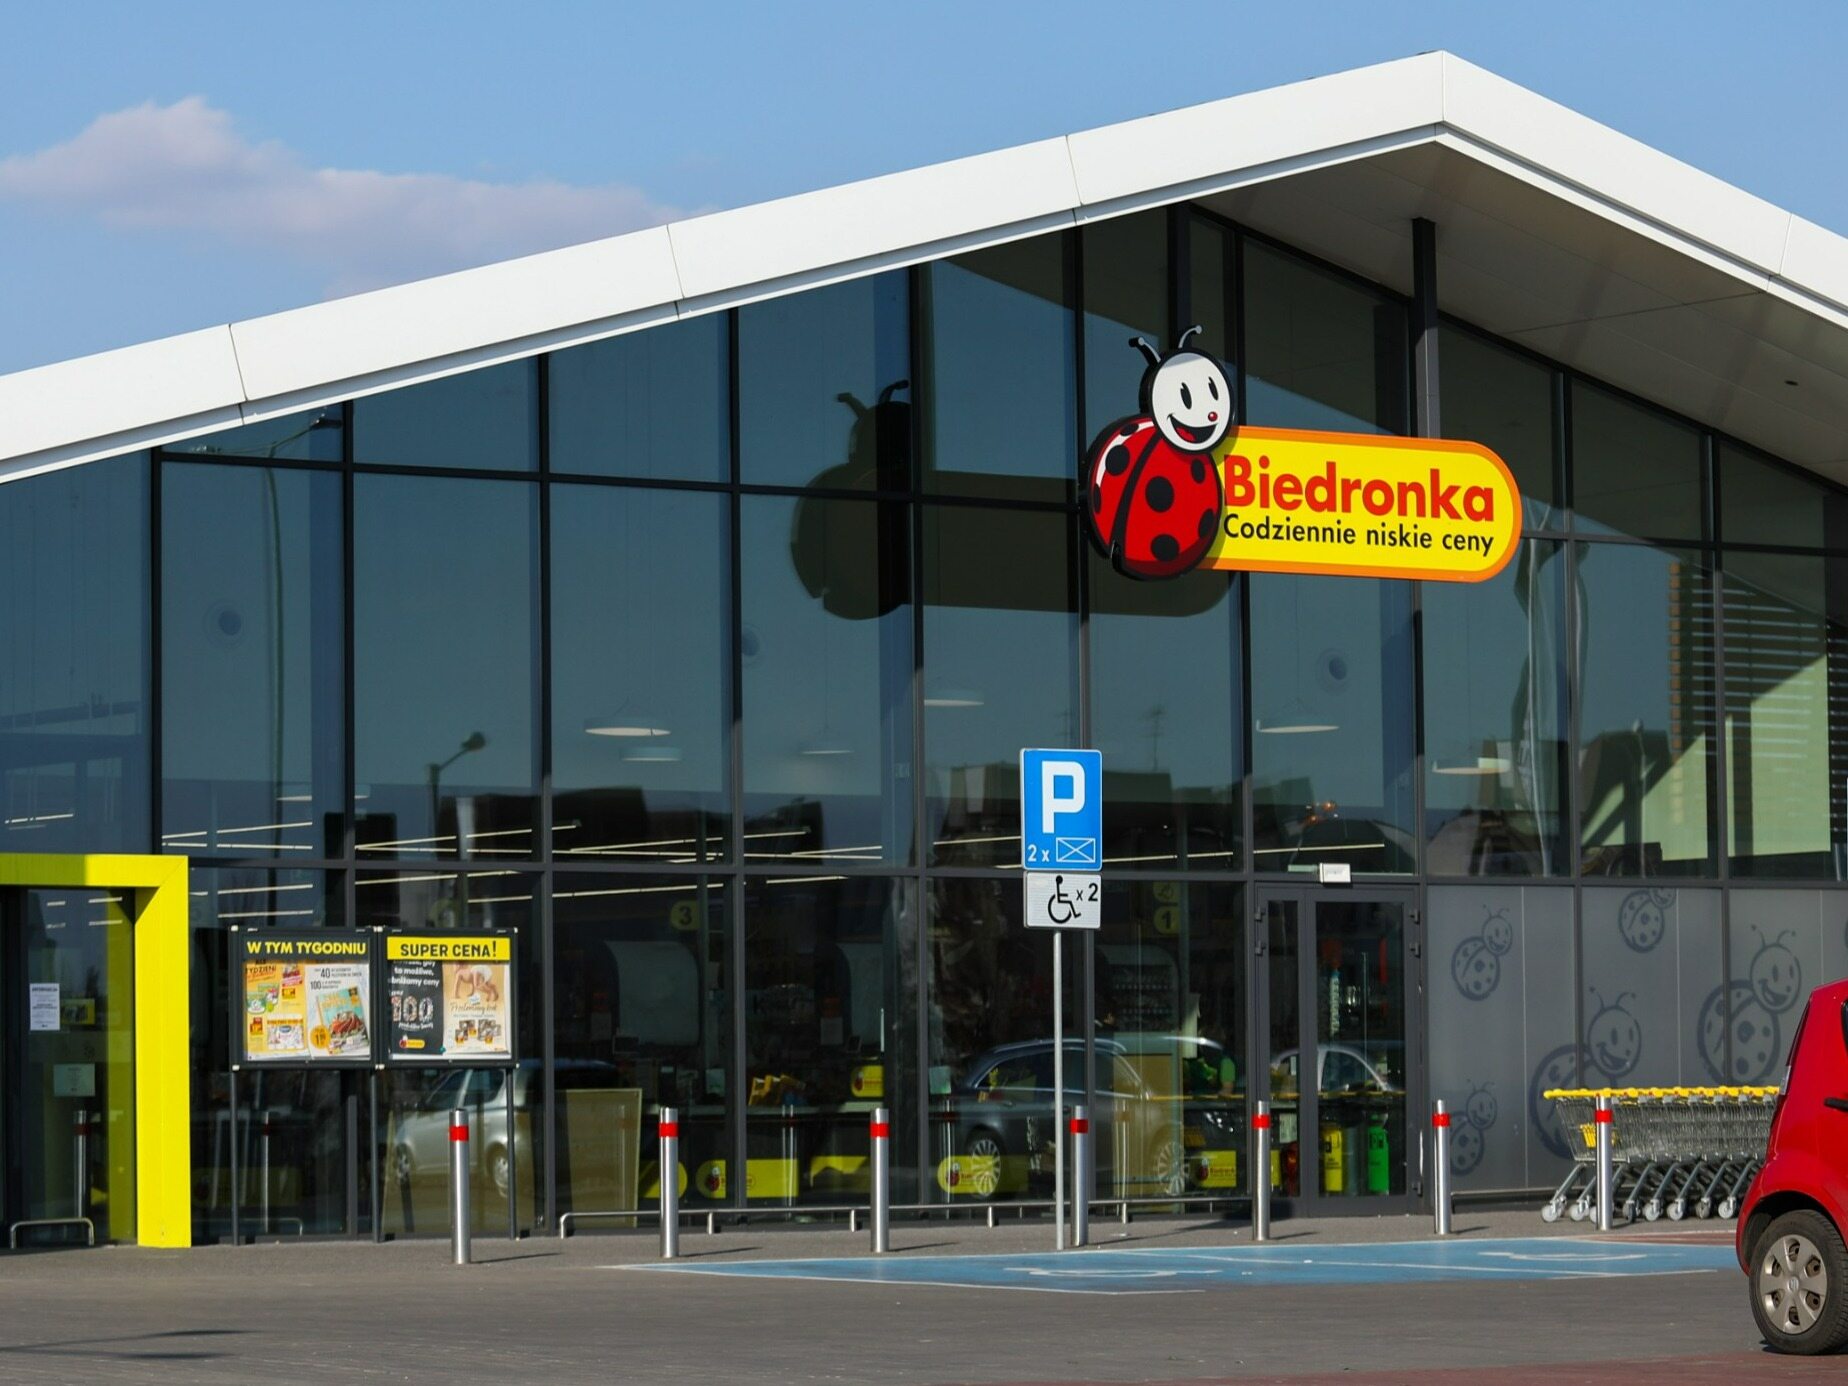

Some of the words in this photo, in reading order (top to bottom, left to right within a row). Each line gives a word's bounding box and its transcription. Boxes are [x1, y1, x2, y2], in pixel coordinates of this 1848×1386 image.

[1223, 454, 1494, 522] Biedronka
[1223, 513, 1356, 545] Codziennie
[1366, 522, 1432, 549] niskie
[1442, 532, 1495, 557] ceny
[1041, 760, 1085, 834] P
[1027, 844, 1037, 862] 2
[1088, 883, 1098, 902] 2
[679, 905, 692, 925] 3
[246, 942, 262, 954] W
[265, 941, 295, 954] TYM
[296, 941, 367, 955] TYGODNIU
[400, 943, 448, 957] SUPER
[452, 940, 497, 957] CENA!
[391, 996, 434, 1023] 100
